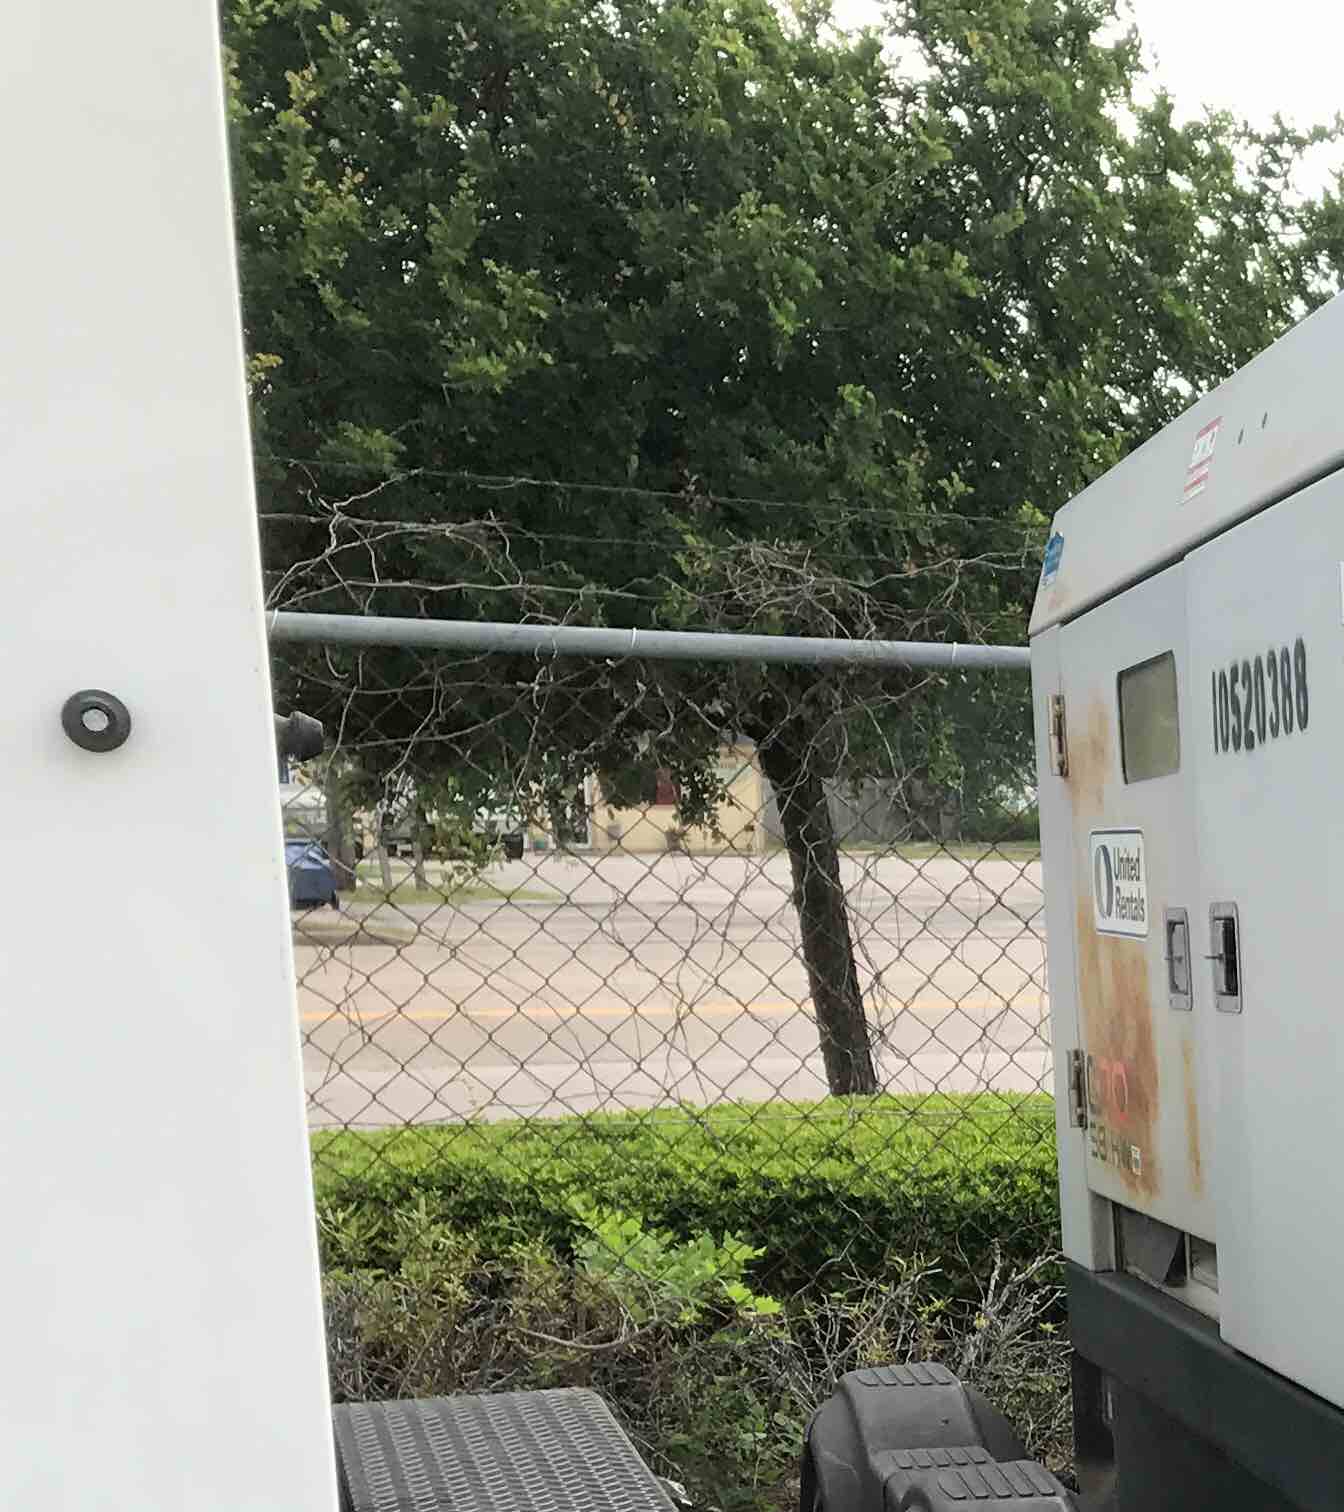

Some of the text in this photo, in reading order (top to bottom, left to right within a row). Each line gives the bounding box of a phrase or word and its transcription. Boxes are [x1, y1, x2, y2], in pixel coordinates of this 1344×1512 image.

[1211, 635, 1310, 755] 10520388
[1113, 847, 1141, 881] United
[1115, 886, 1145, 922] Rentals
